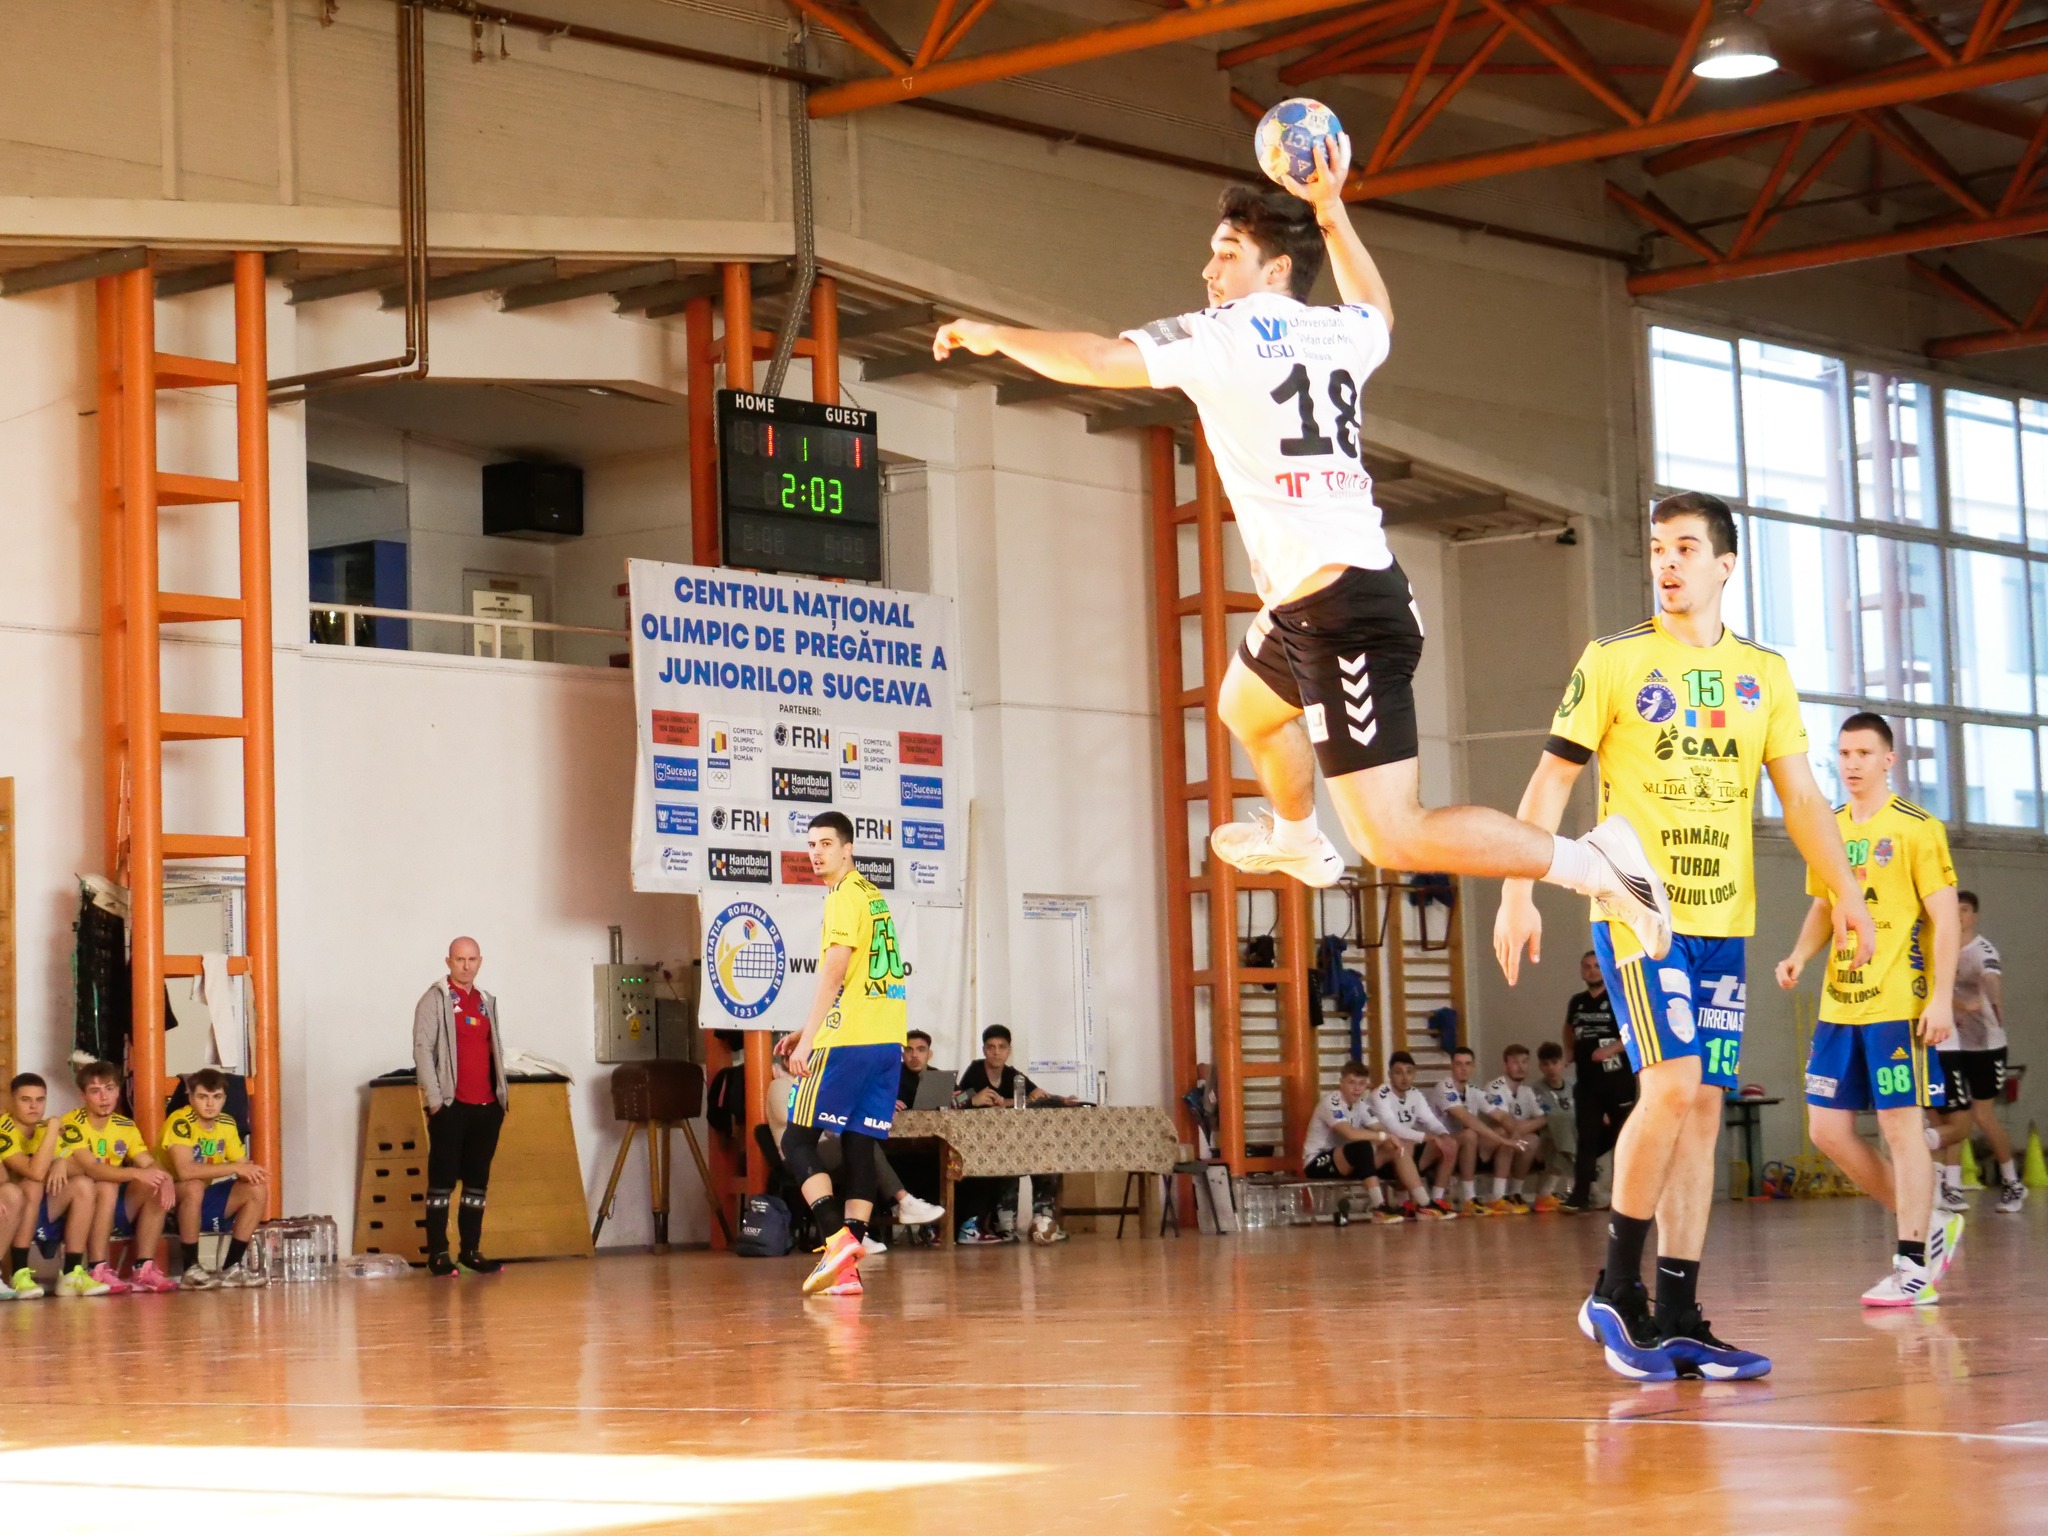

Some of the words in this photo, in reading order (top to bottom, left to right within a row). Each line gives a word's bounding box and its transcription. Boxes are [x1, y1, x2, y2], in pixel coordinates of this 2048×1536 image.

[1256, 344, 1295, 358] USU
[735, 394, 775, 413] HOME
[825, 408, 867, 427] GUEST
[1270, 362, 1361, 459] 18
[767, 425, 774, 457] 1
[803, 437, 808, 461] 1
[855, 437, 861, 468] 1
[781, 473, 843, 514] 2:03
[674, 576, 789, 614] CENTRUL
[793, 590, 915, 630] NAȚIONAL
[641, 613, 750, 650] OLIMPIC
[755, 626, 785, 653] DE
[795, 629, 923, 668] PREGĂTIRE
[931, 646, 948, 671] A
[659, 657, 813, 696] JUNIORILOR
[822, 672, 933, 708] SUCEAVA
[1682, 669, 1725, 708] 15
[779, 704, 821, 716] PARTENERI:
[732, 727, 763, 735] COMITETUL
[732, 736, 755, 744] OLIMPIC
[792, 726, 829, 749] FRH
[1682, 736, 1739, 758] CAA
[666, 765, 697, 777] Suceava
[791, 773, 829, 787] Handbalul
[791, 785, 806, 795] Sport
[913, 783, 942, 795] Suceava
[731, 809, 769, 832] FRH
[855, 817, 892, 840] FRH
[729, 853, 769, 867] Handbalul
[1846, 838, 1870, 867] 98
[729, 866, 745, 877] Sport
[855, 860, 892, 874] Handbalul
[1670, 855, 1720, 877] TURDA
[1663, 881, 1708, 906] SILIUL
[1709, 880, 1737, 905] LOCAL
[769, 925, 780, 942] DE
[772, 951, 785, 990] VOLEI
[733, 1006, 758, 1017] 1931
[1705, 1037, 1739, 1076] 15
[1876, 1064, 1912, 1096] 98
[818, 1112, 848, 1126] DAC
